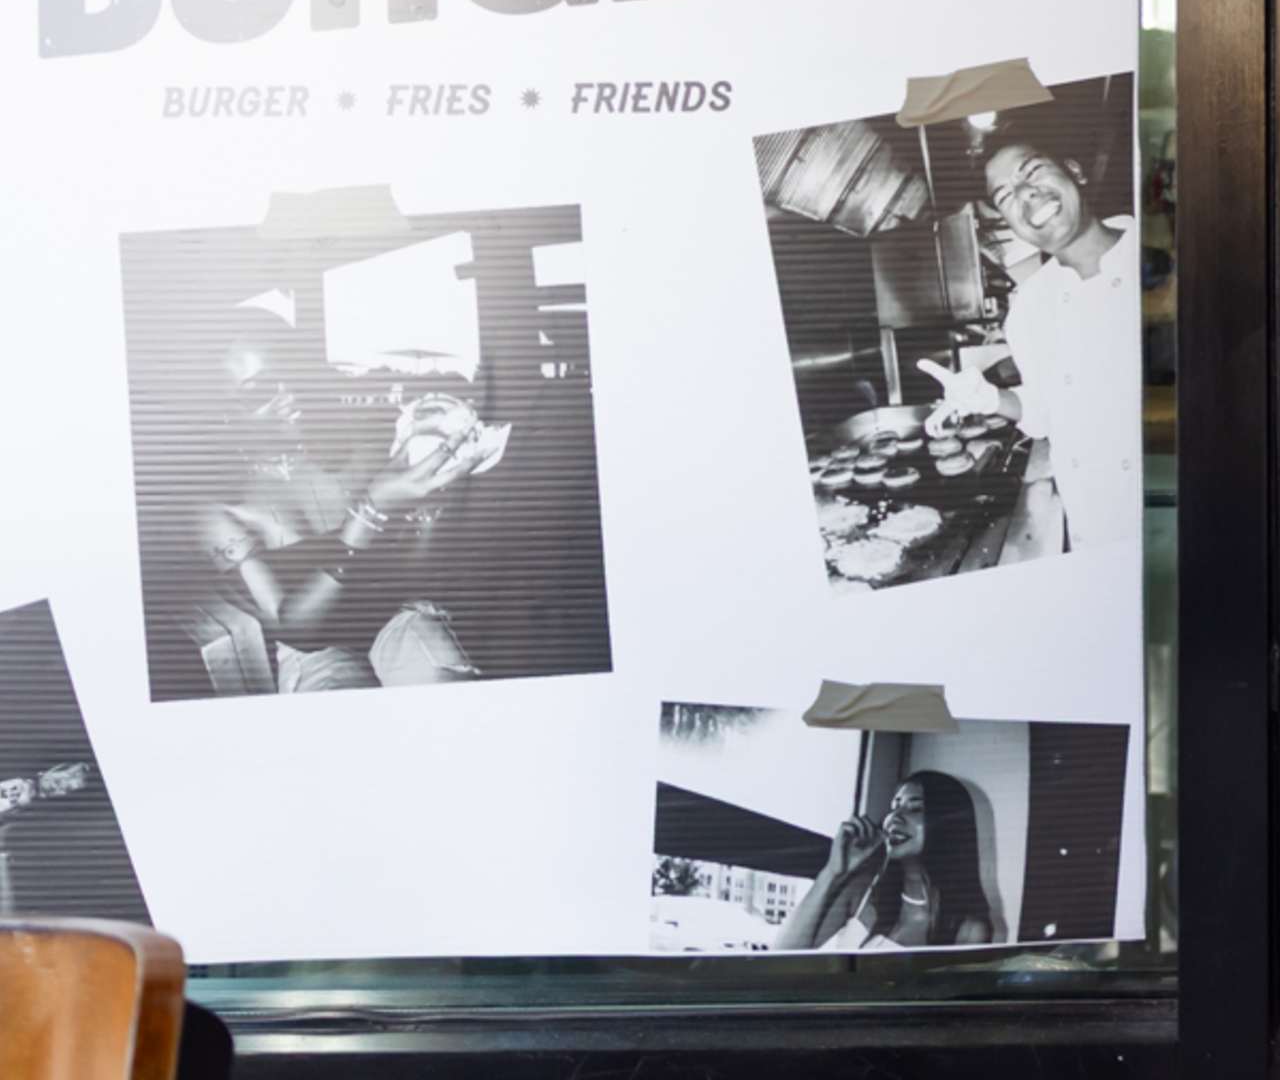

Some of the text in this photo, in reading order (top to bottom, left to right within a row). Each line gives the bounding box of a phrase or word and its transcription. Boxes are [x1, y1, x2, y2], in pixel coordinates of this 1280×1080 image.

[162, 80, 732, 120] BURGER FRIES FRIENDS
